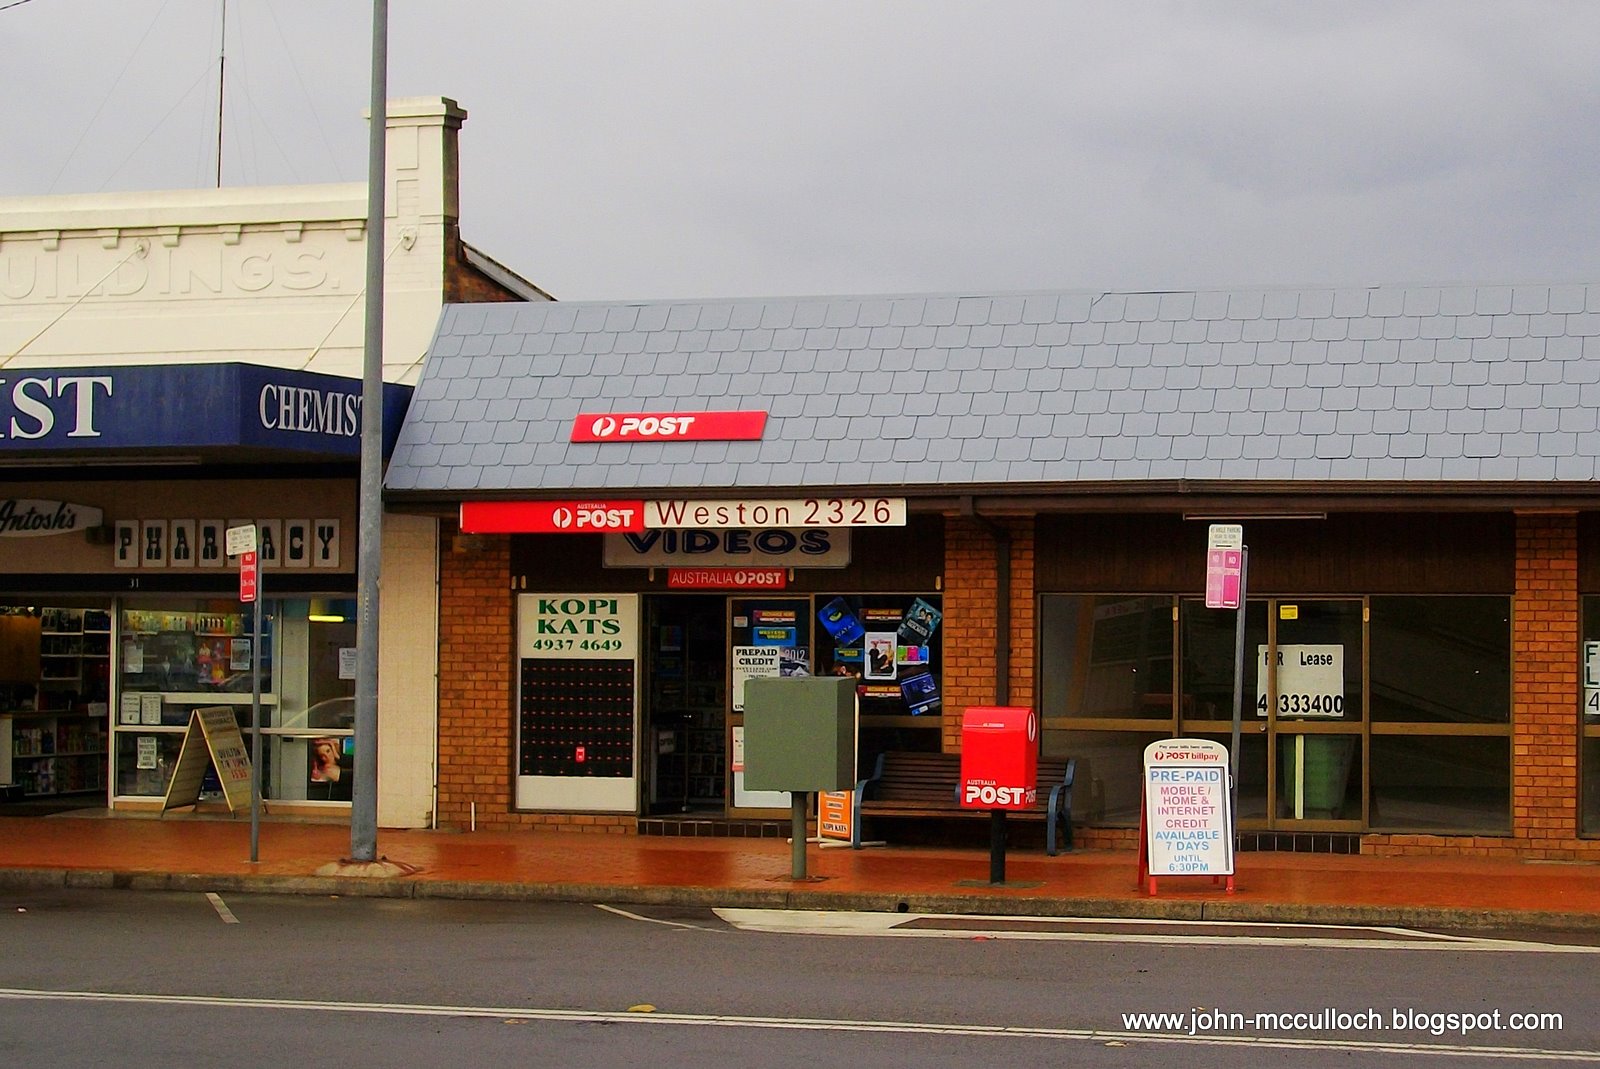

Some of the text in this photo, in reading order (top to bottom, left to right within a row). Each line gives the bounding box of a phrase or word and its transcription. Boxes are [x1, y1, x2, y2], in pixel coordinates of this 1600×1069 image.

[0, 376, 113, 440] ST
[619, 416, 696, 435] POST
[656, 499, 891, 525] Weston 2326
[576, 509, 635, 528] POST
[119, 526, 335, 561] PHARACY
[622, 529, 831, 555] VIDEOS
[129, 578, 139, 588] 31
[671, 572, 782, 585] AUSTRALIA POST
[538, 599, 618, 615] KOPI
[537, 619, 621, 635] KATS
[533, 639, 622, 651] 4937 4649
[735, 648, 778, 656] PREPAID
[784, 649, 806, 660] 2012
[738, 658, 775, 666] CREDIT
[1300, 651, 1333, 666] Lease
[1257, 693, 1344, 713] 4333400
[1166, 752, 1219, 761] POST billpay
[1151, 770, 1219, 782] PRE-PAID
[966, 785, 1025, 805] POST
[1160, 786, 1205, 796] MOBILE
[1163, 796, 1209, 806] HOME &
[1157, 806, 1215, 816] INTERNET
[1165, 819, 1209, 829] CREDIT
[1155, 831, 1219, 841] AVAILABLE
[1166, 841, 1210, 851] 7 DAYS
[1168, 863, 1209, 872] 6:30PM
